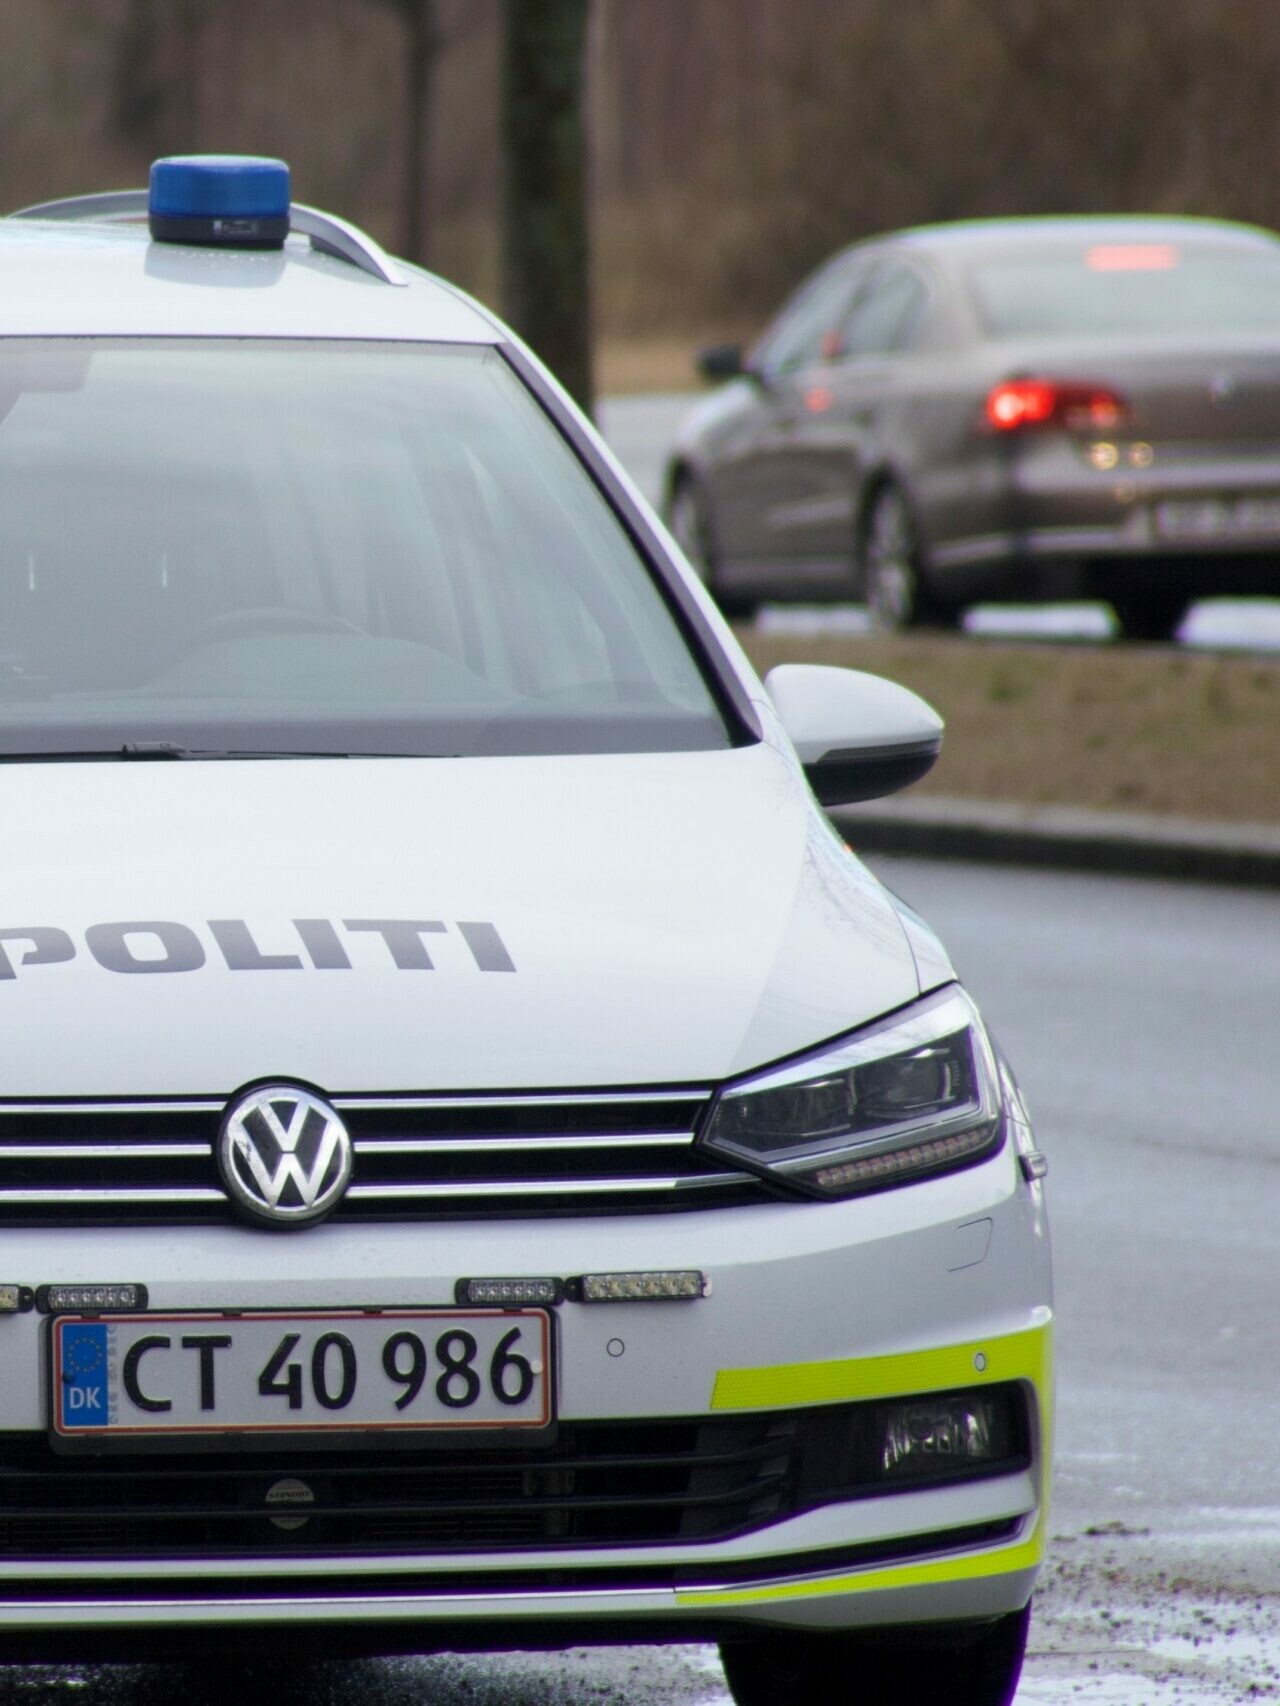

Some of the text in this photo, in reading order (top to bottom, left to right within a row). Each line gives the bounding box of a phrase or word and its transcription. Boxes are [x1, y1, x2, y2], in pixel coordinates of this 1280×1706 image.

[226, 1092, 347, 1214] VW
[69, 1387, 101, 1409] DK
[123, 1334, 232, 1412] CT
[258, 1332, 358, 1410] 40
[382, 1326, 535, 1411] 986
